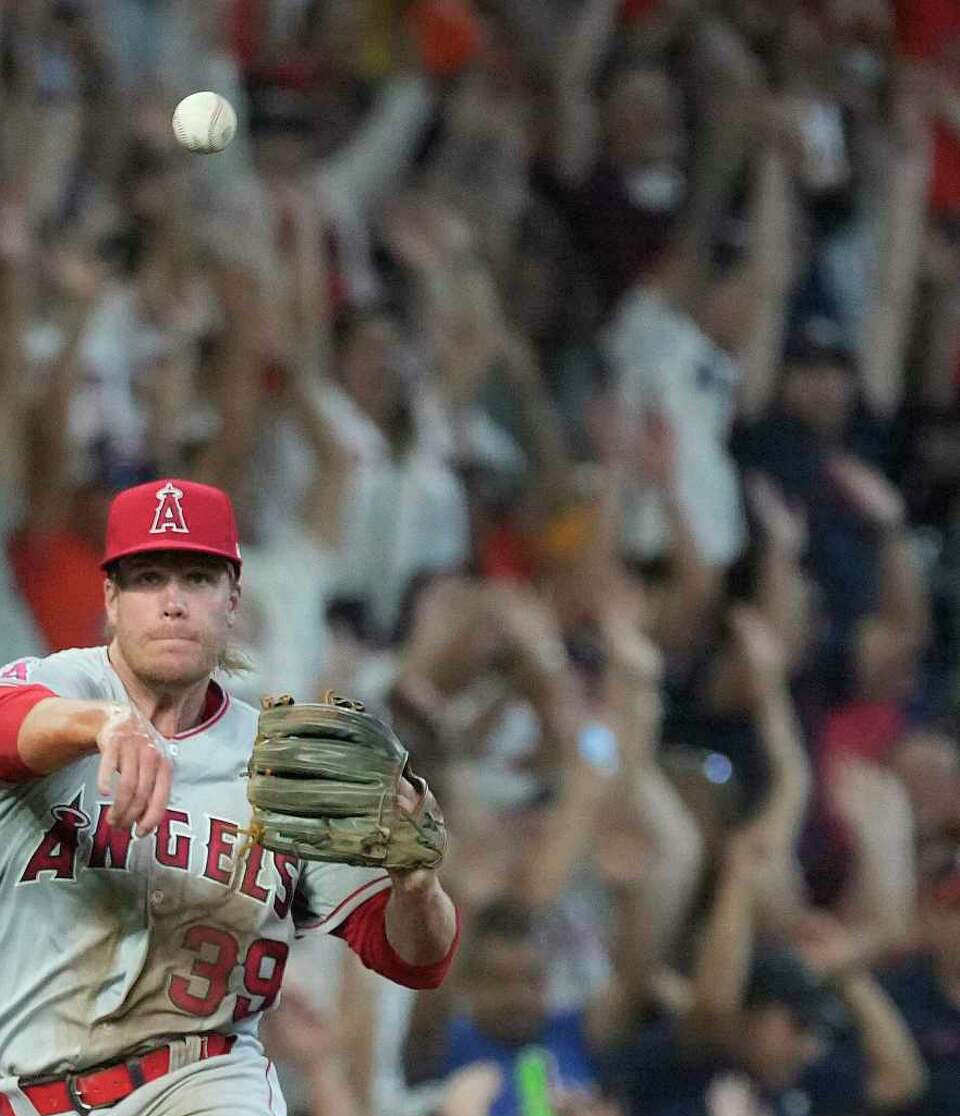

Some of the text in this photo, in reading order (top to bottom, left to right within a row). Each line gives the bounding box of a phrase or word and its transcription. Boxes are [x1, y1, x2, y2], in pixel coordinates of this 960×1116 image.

[148, 480, 190, 534] A
[14, 783, 300, 921] ANGELS
[167, 923, 290, 1025] 39
